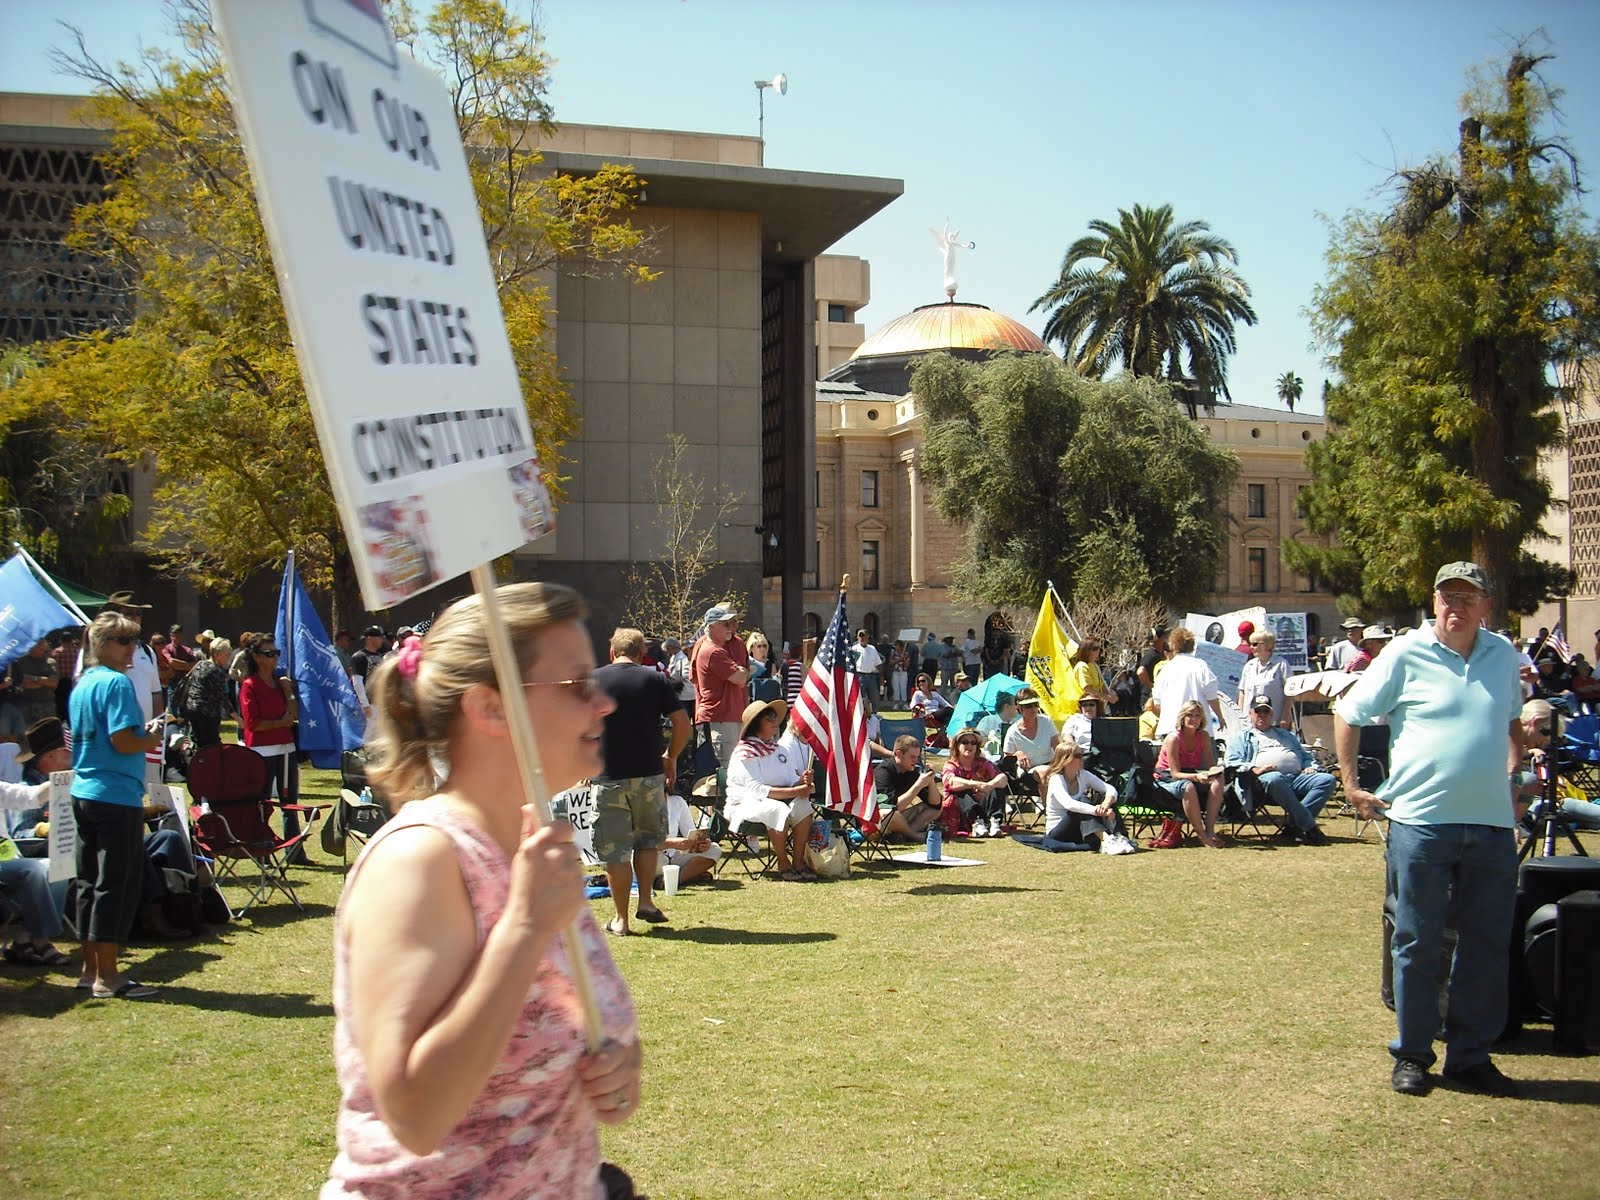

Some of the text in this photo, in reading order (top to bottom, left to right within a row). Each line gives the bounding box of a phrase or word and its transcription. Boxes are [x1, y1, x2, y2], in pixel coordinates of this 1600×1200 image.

[290, 50, 441, 171] ON OUR
[327, 175, 456, 266] UNITED
[360, 292, 481, 366] STATES
[352, 407, 526, 484] CONSTITUTION
